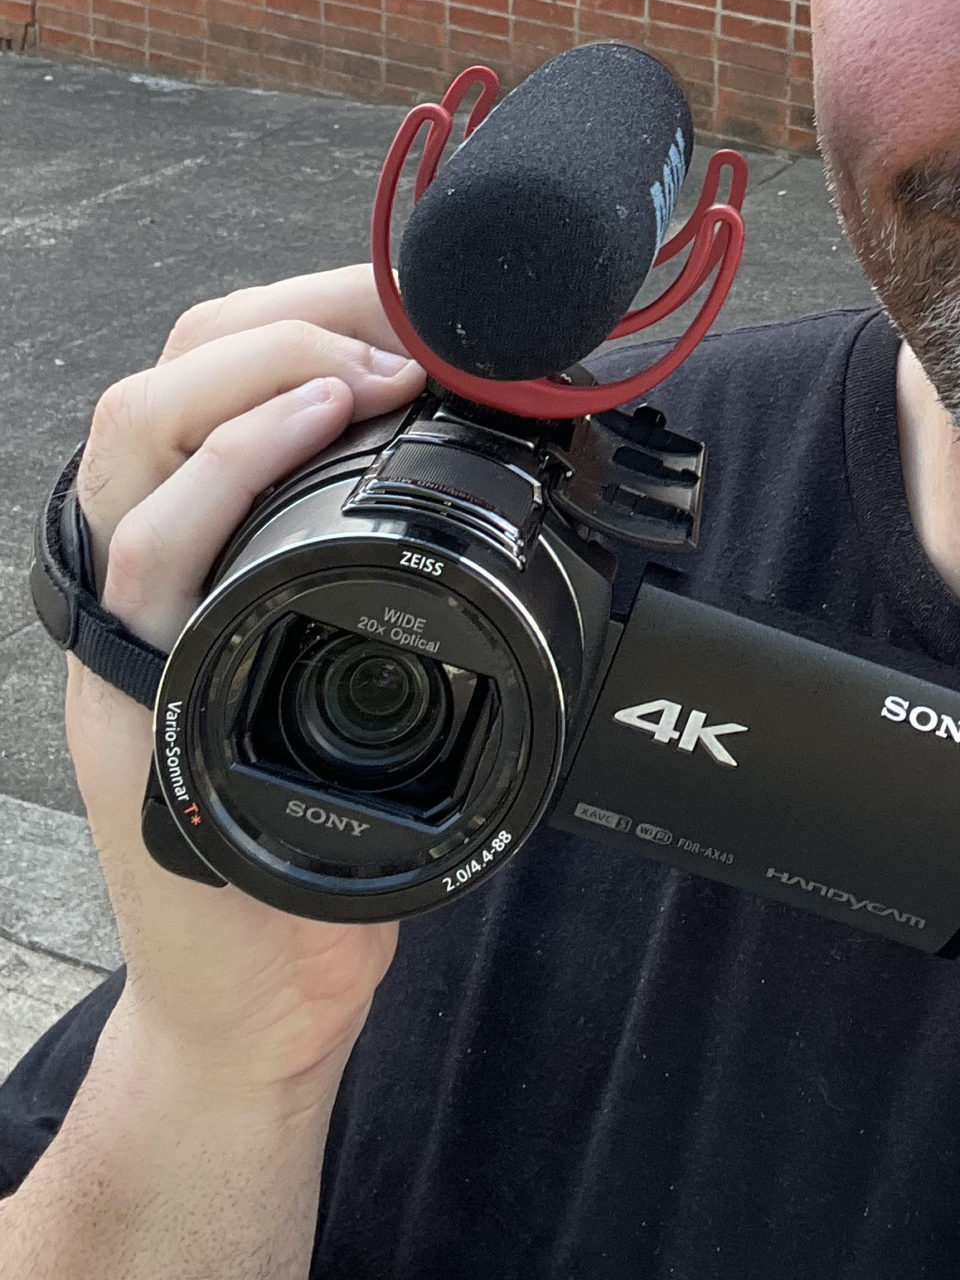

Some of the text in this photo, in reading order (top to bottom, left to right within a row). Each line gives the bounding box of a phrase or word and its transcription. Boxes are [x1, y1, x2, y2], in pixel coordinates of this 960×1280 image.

[399, 550, 445, 577] ZEISS
[357, 615, 441, 653] 20x Optical
[383, 606, 427, 634] WIDE
[164, 700, 190, 801] Vario-Sonnar
[613, 698, 749, 768] 4K
[285, 800, 371, 838] SONY
[441, 830, 513, 893] 2.0/4.4-88
